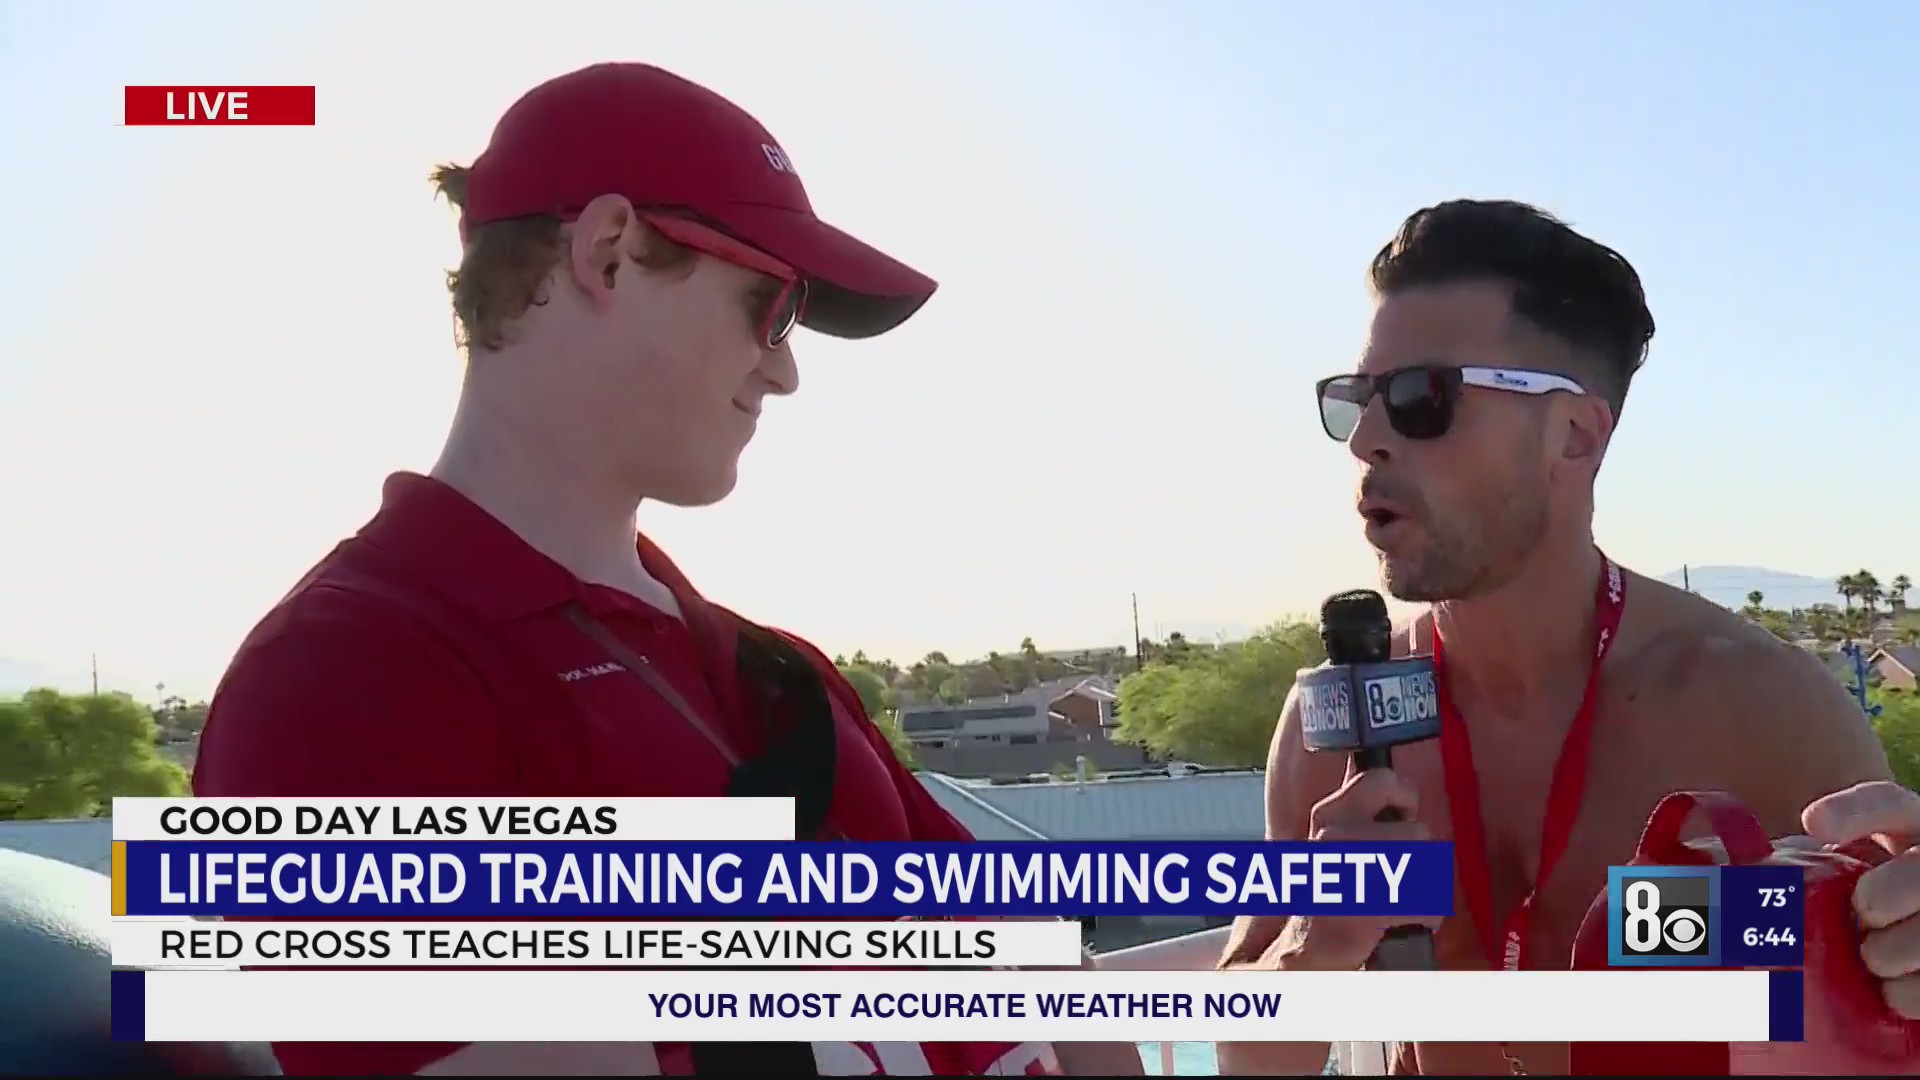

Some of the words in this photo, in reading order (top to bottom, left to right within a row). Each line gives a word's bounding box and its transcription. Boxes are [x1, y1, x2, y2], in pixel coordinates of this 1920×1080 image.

[1401, 671, 1435, 697] NEWS
[1369, 683, 1386, 724] 8
[1404, 694, 1437, 722] NOW
[1317, 704, 1350, 731] NOW
